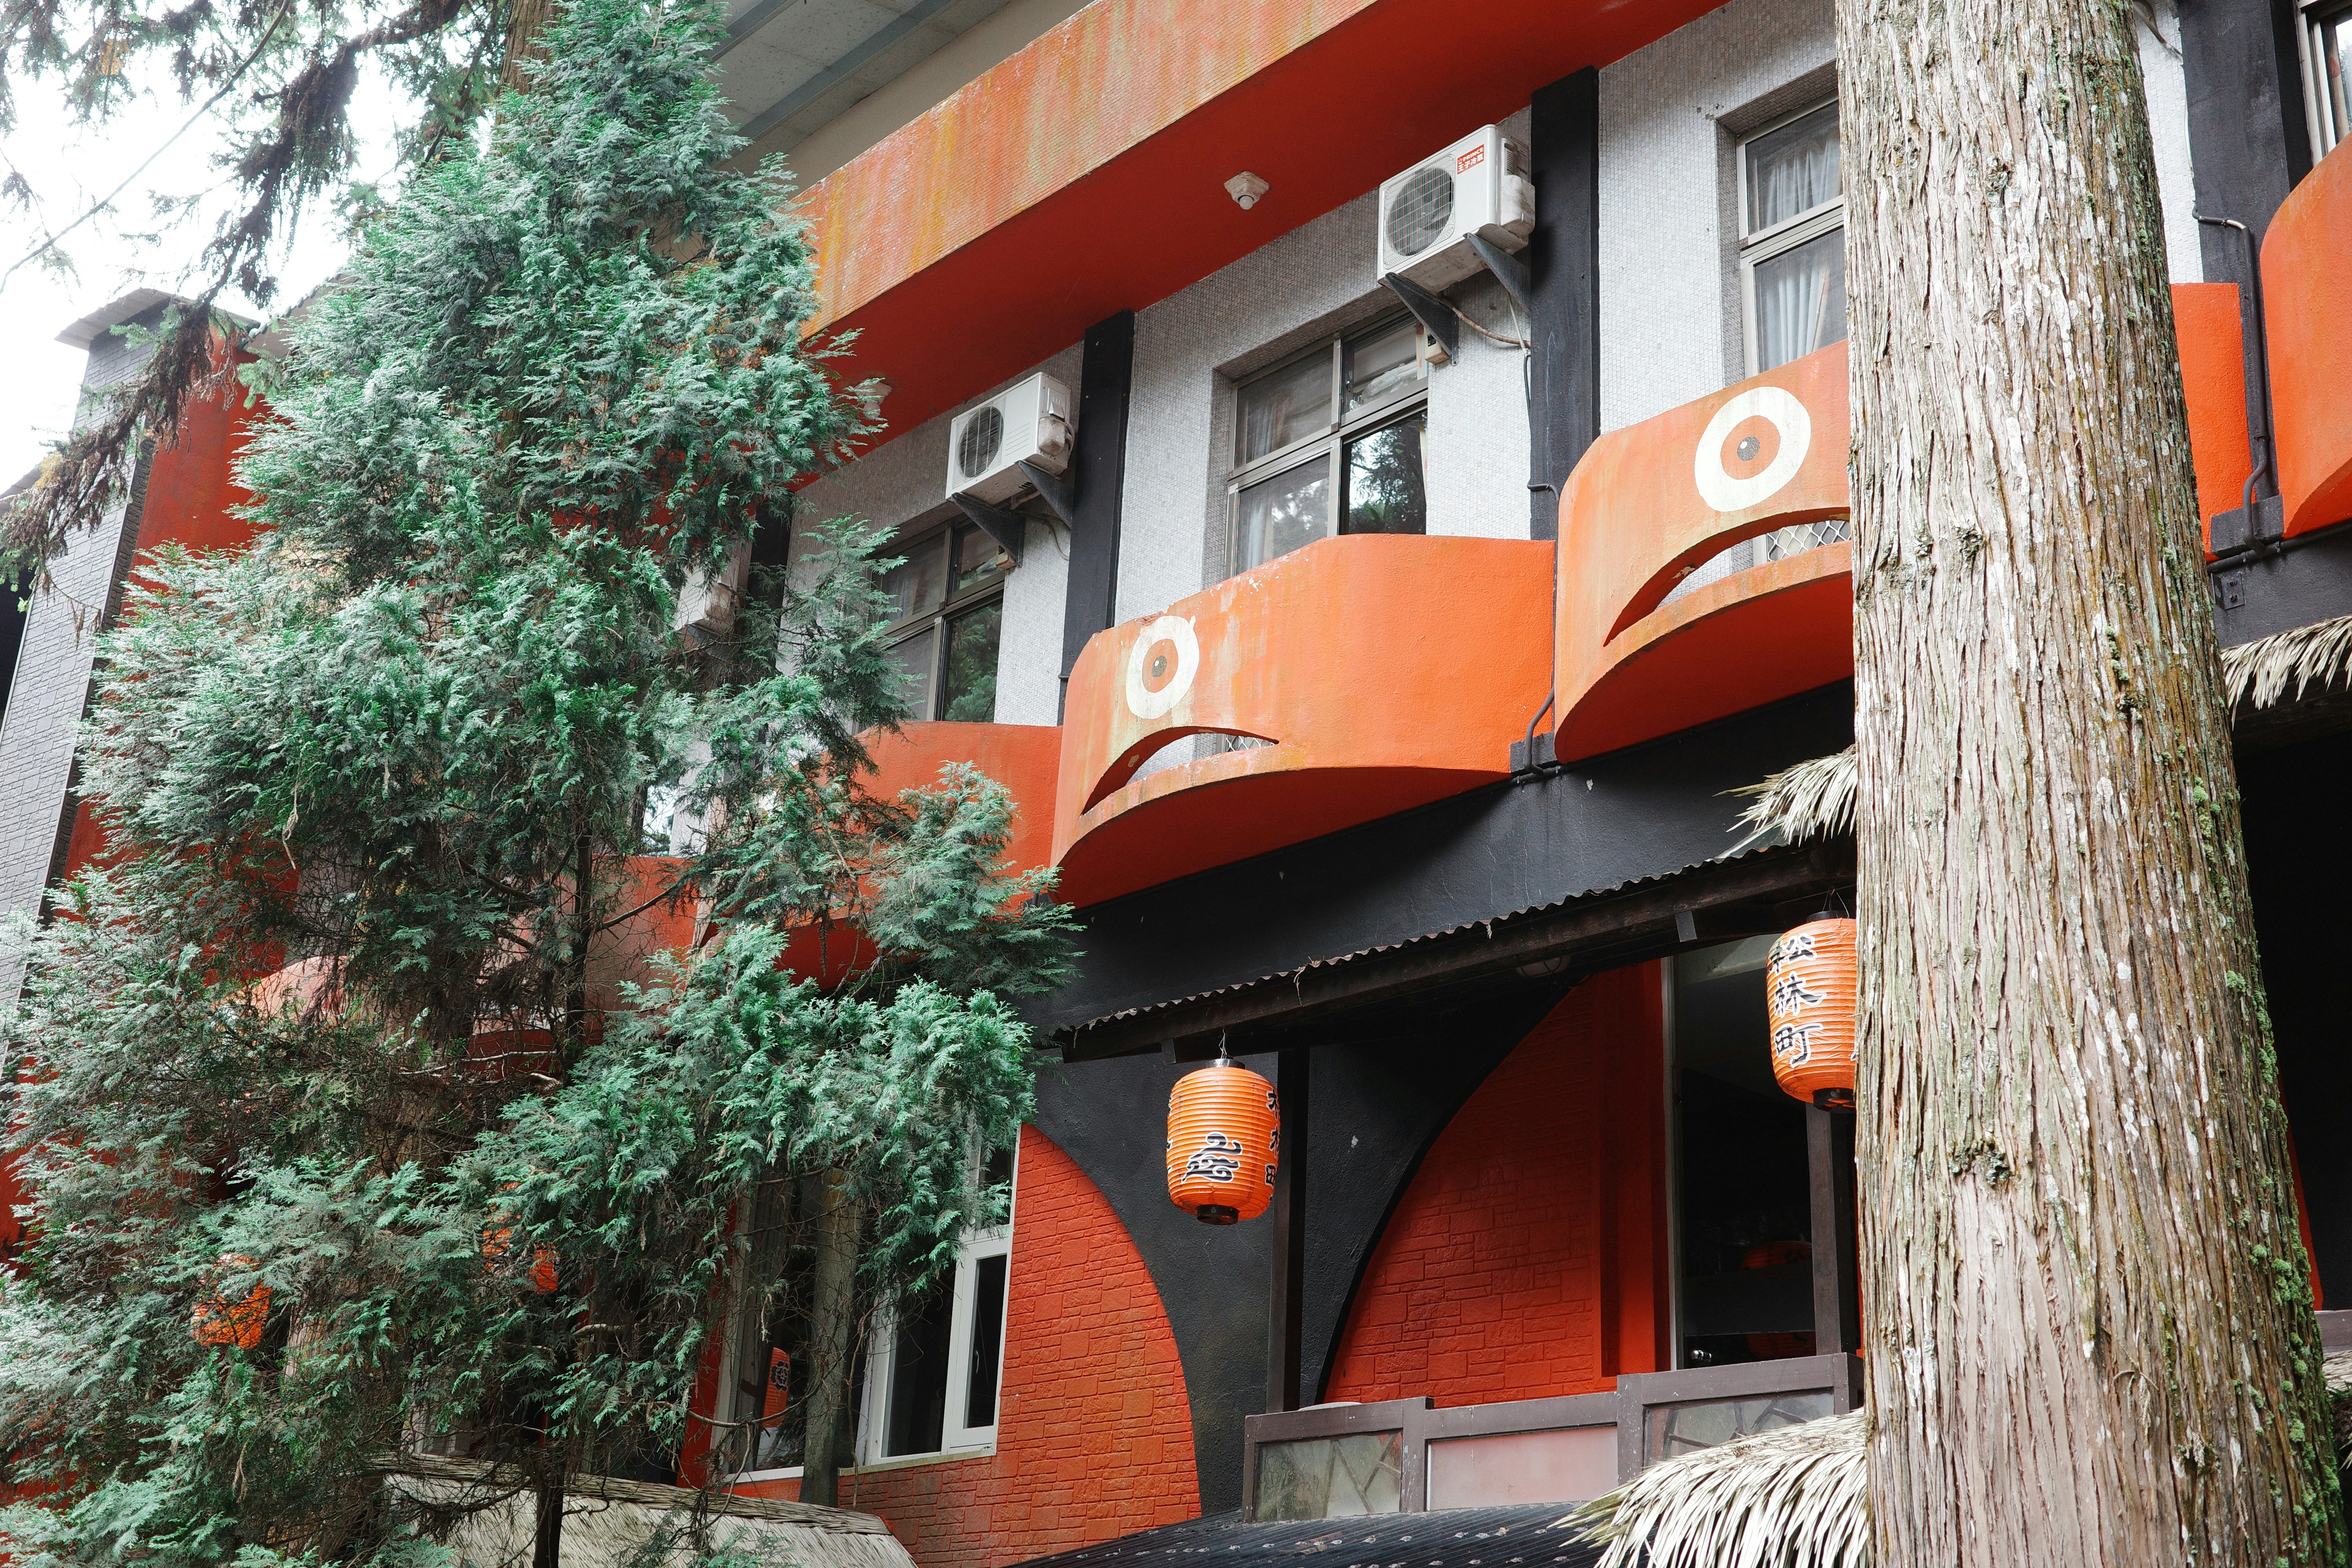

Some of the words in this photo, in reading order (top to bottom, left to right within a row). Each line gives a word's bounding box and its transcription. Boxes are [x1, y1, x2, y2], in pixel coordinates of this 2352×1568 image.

[1458, 153, 1483, 172] 王子冷氣
[1463, 147, 1483, 162] PRINCE
[1769, 933, 1827, 1068] 松林町
